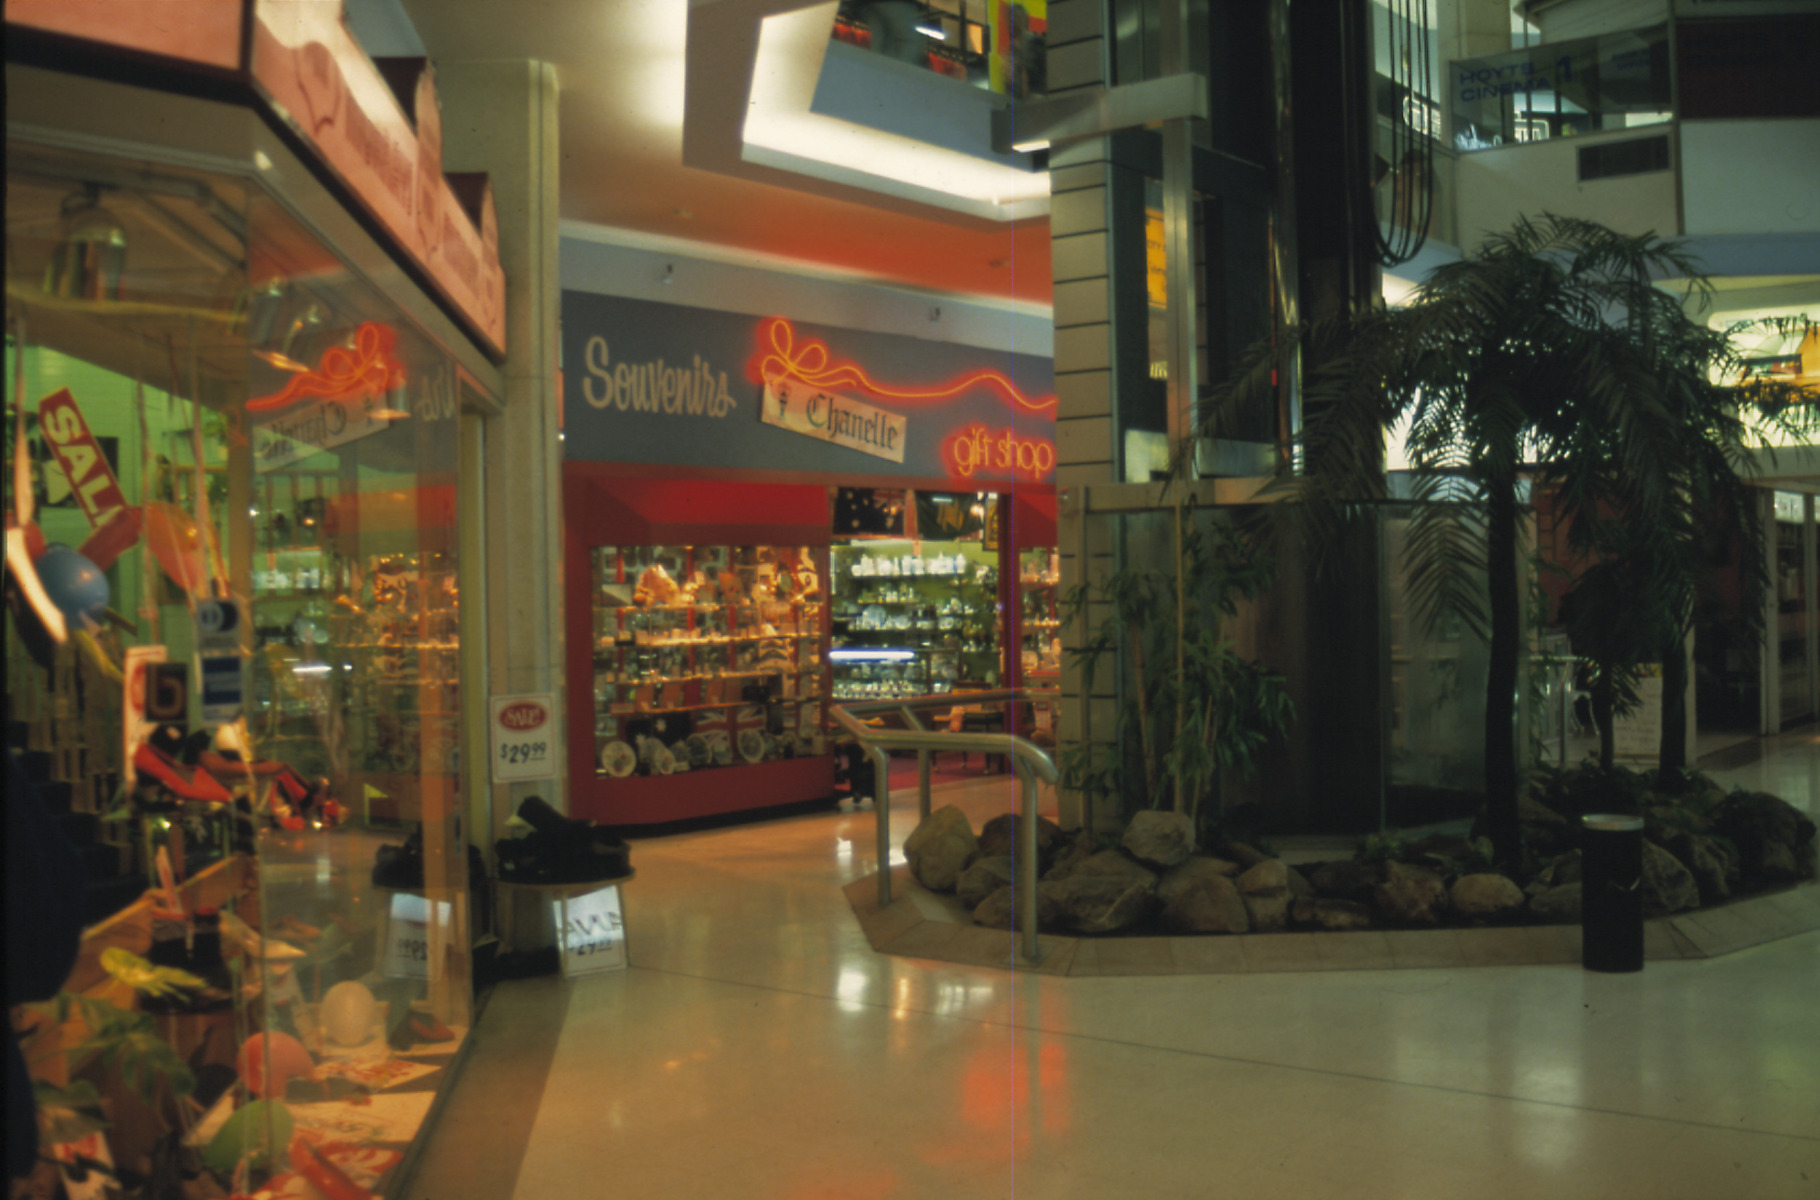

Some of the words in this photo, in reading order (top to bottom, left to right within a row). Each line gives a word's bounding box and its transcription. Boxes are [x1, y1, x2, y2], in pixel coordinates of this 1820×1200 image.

[1459, 61, 1535, 85] HOYTS
[1461, 76, 1552, 102] CINEMA
[583, 335, 737, 418] Souvenirs
[806, 393, 898, 451] Chanelle
[953, 427, 992, 476] gift
[994, 430, 1054, 480] shop
